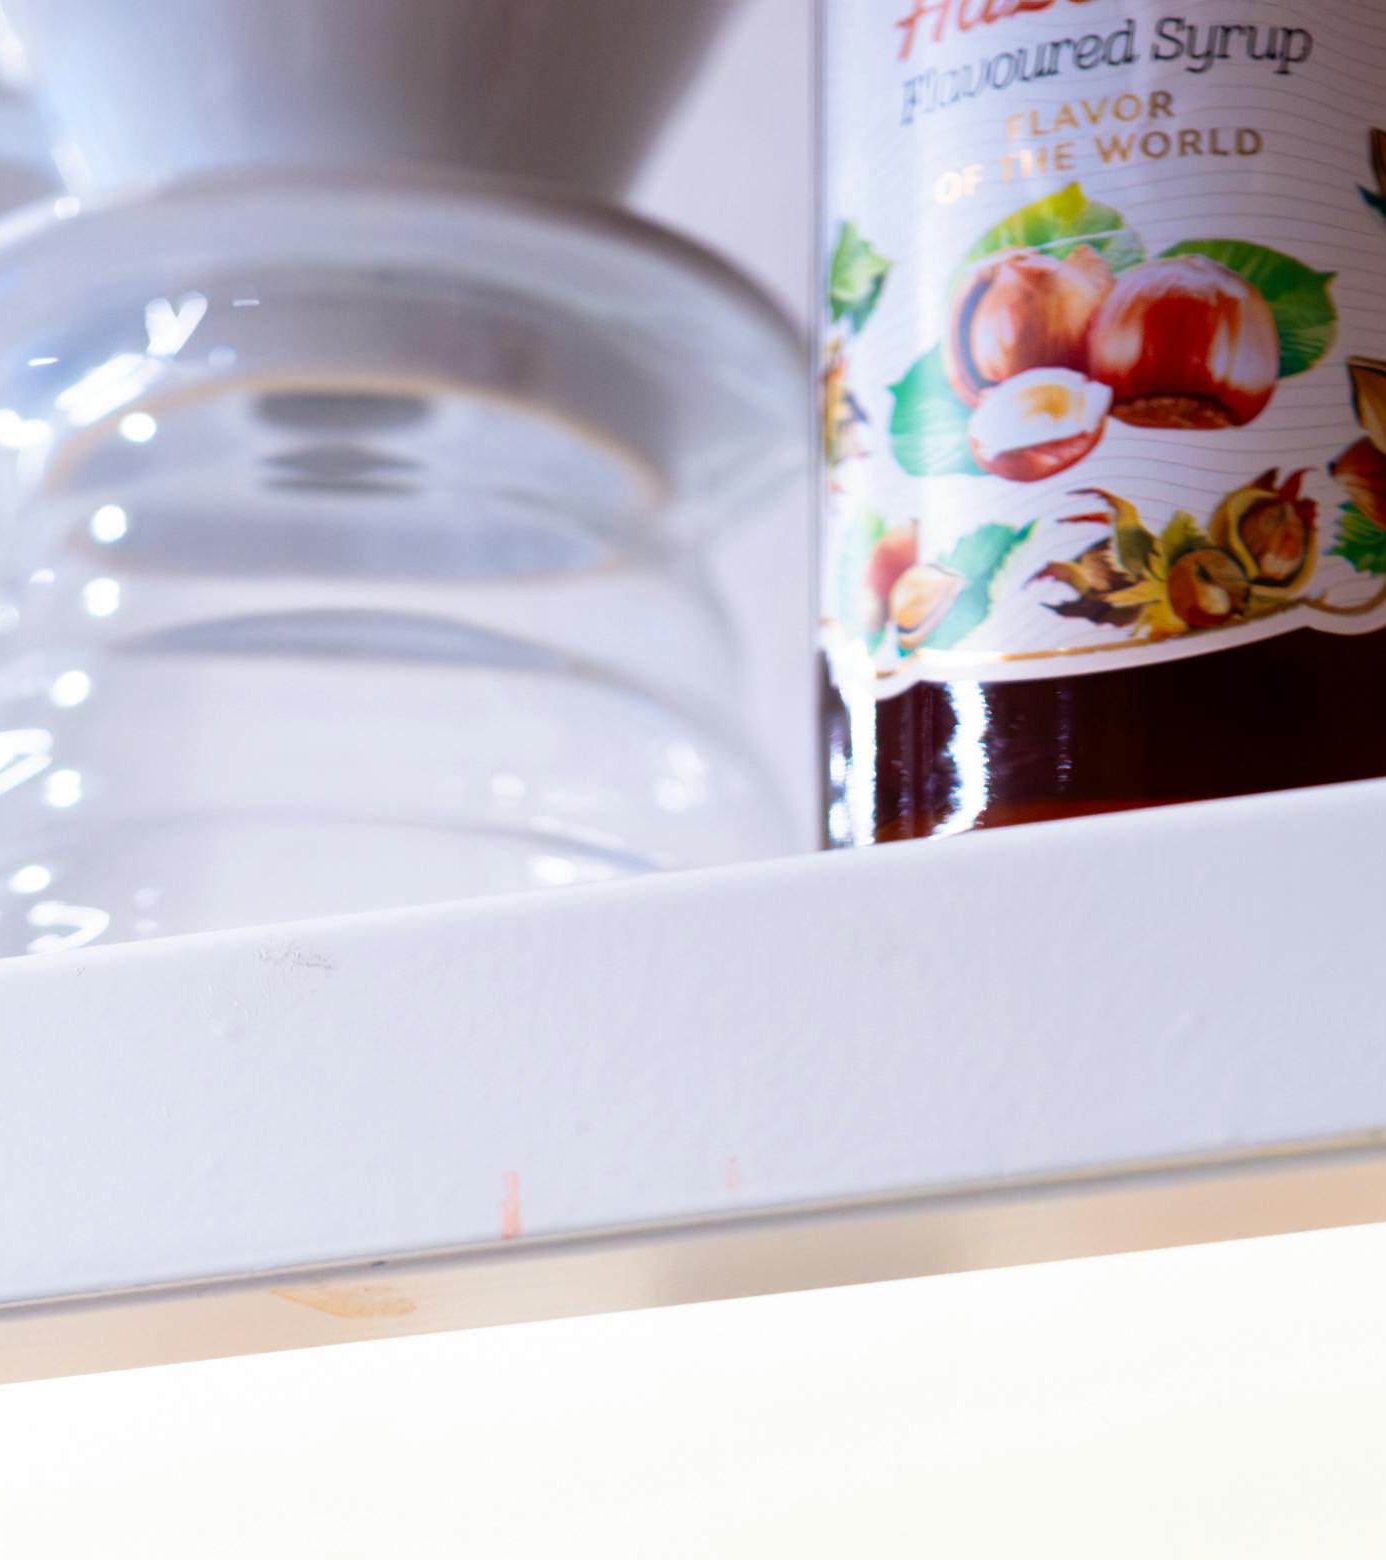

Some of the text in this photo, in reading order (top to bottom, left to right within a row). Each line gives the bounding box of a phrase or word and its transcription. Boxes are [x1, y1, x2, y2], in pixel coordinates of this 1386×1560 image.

[1152, 16, 1313, 75] Syrup
[1005, 90, 1175, 141] FLAVOR
[933, 127, 1264, 205] OF THE WORLD
